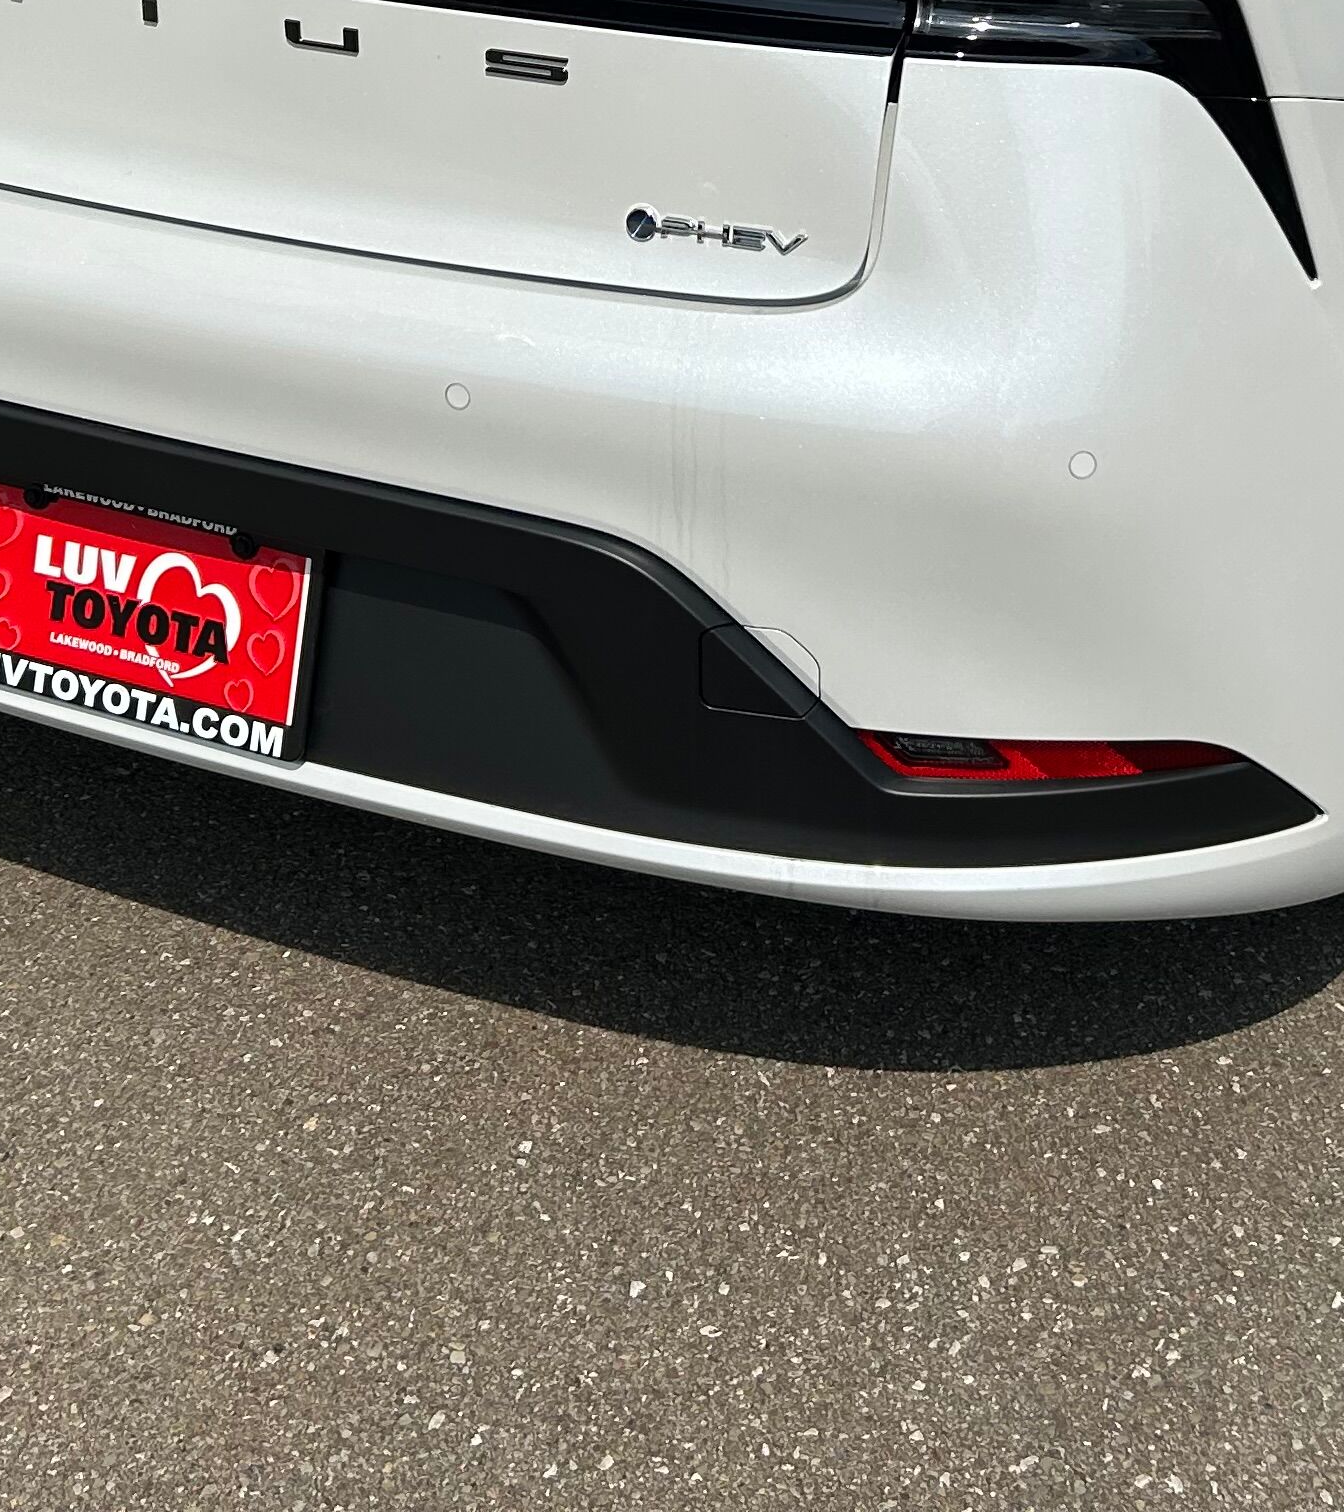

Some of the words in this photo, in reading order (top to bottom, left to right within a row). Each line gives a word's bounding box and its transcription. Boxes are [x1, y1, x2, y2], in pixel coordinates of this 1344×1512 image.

[660, 213, 809, 256] PHEV
[32, 533, 138, 594] LUV
[45, 580, 230, 665] TOYOTA
[49, 630, 114, 657] LAKEWOOD
[119, 648, 181, 675] BRADFORD
